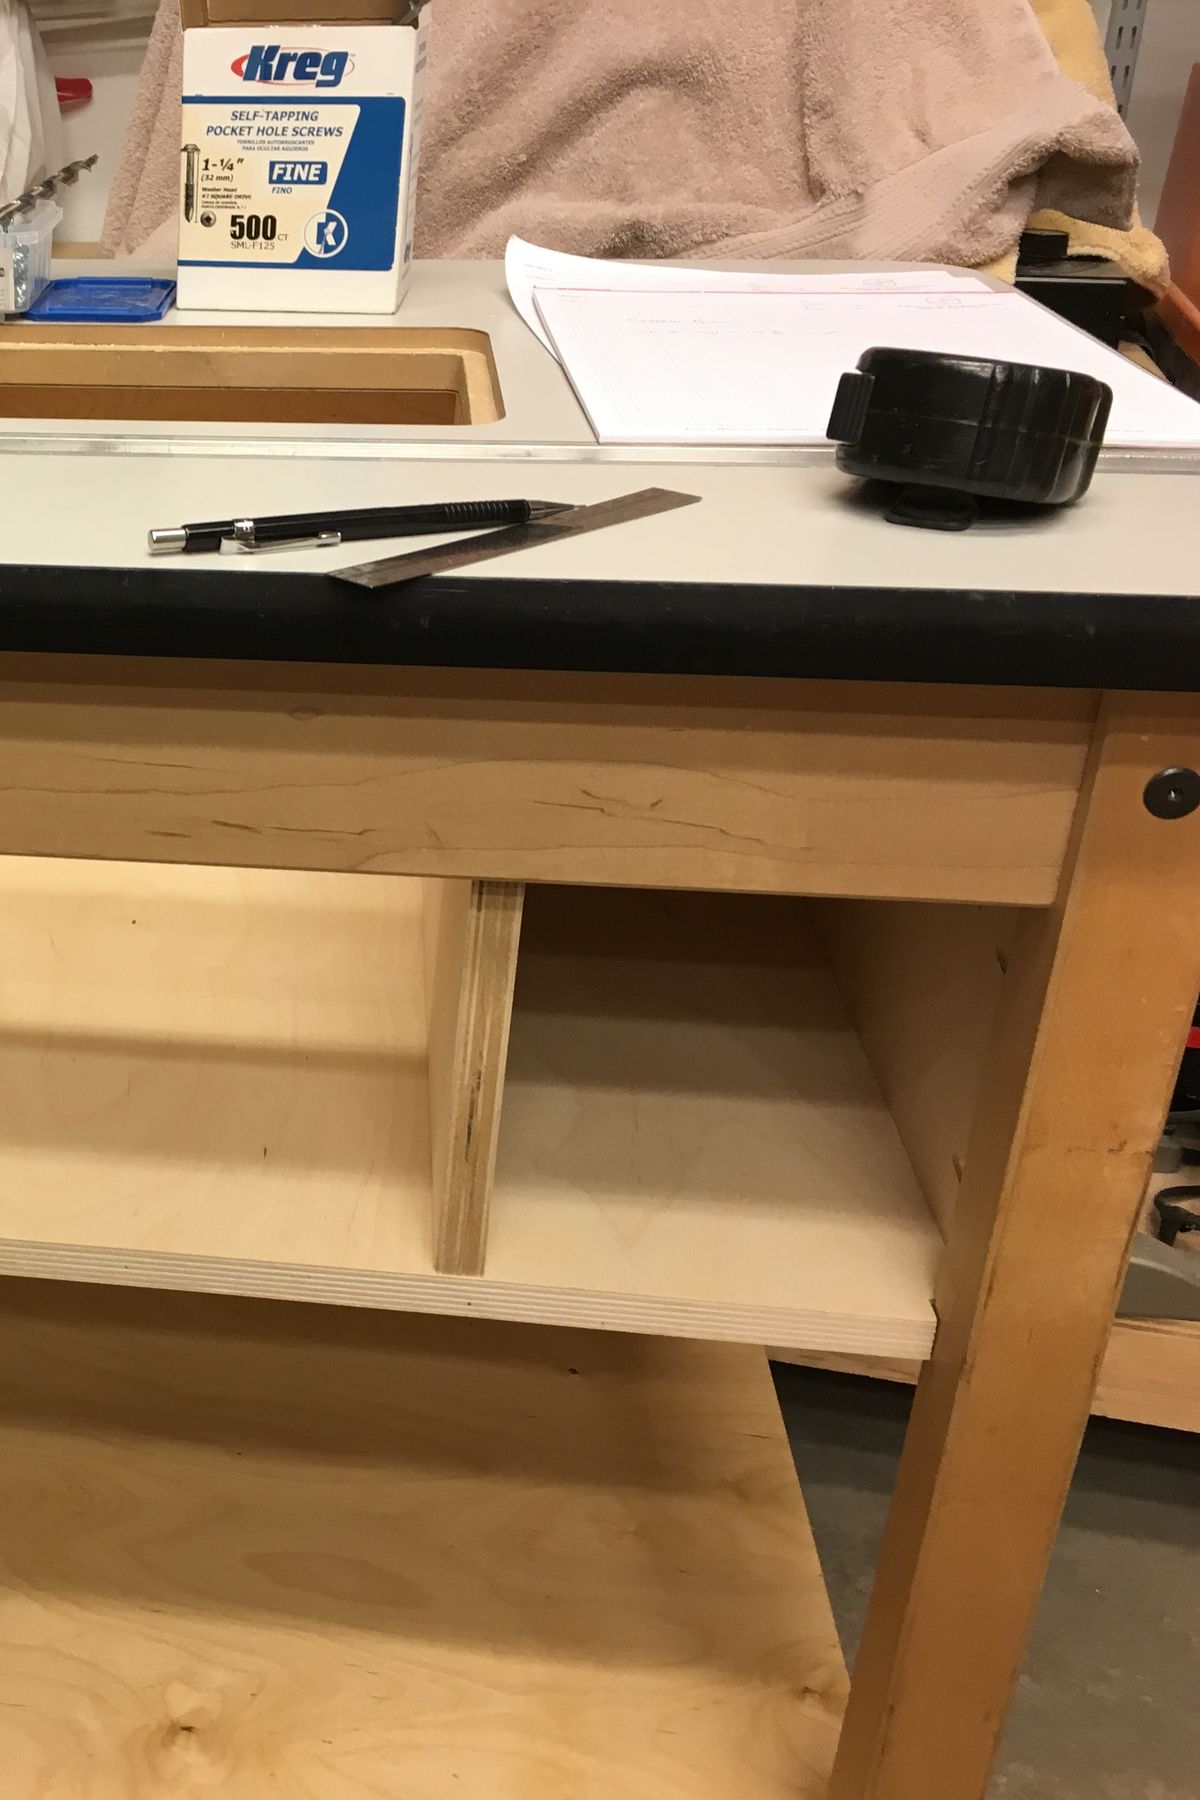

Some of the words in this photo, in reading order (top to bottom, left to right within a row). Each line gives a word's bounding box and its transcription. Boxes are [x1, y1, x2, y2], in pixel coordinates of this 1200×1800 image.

[243, 45, 349, 88] Kreg
[230, 110, 319, 122] SELF-TAPPING
[206, 125, 255, 137] POCKET
[256, 126, 288, 137] HOLE
[291, 126, 344, 138] SCREWS
[271, 163, 322, 181] FINE
[230, 214, 277, 240] 500
[277, 233, 290, 241] CT
[230, 241, 276, 250] SML-F125
